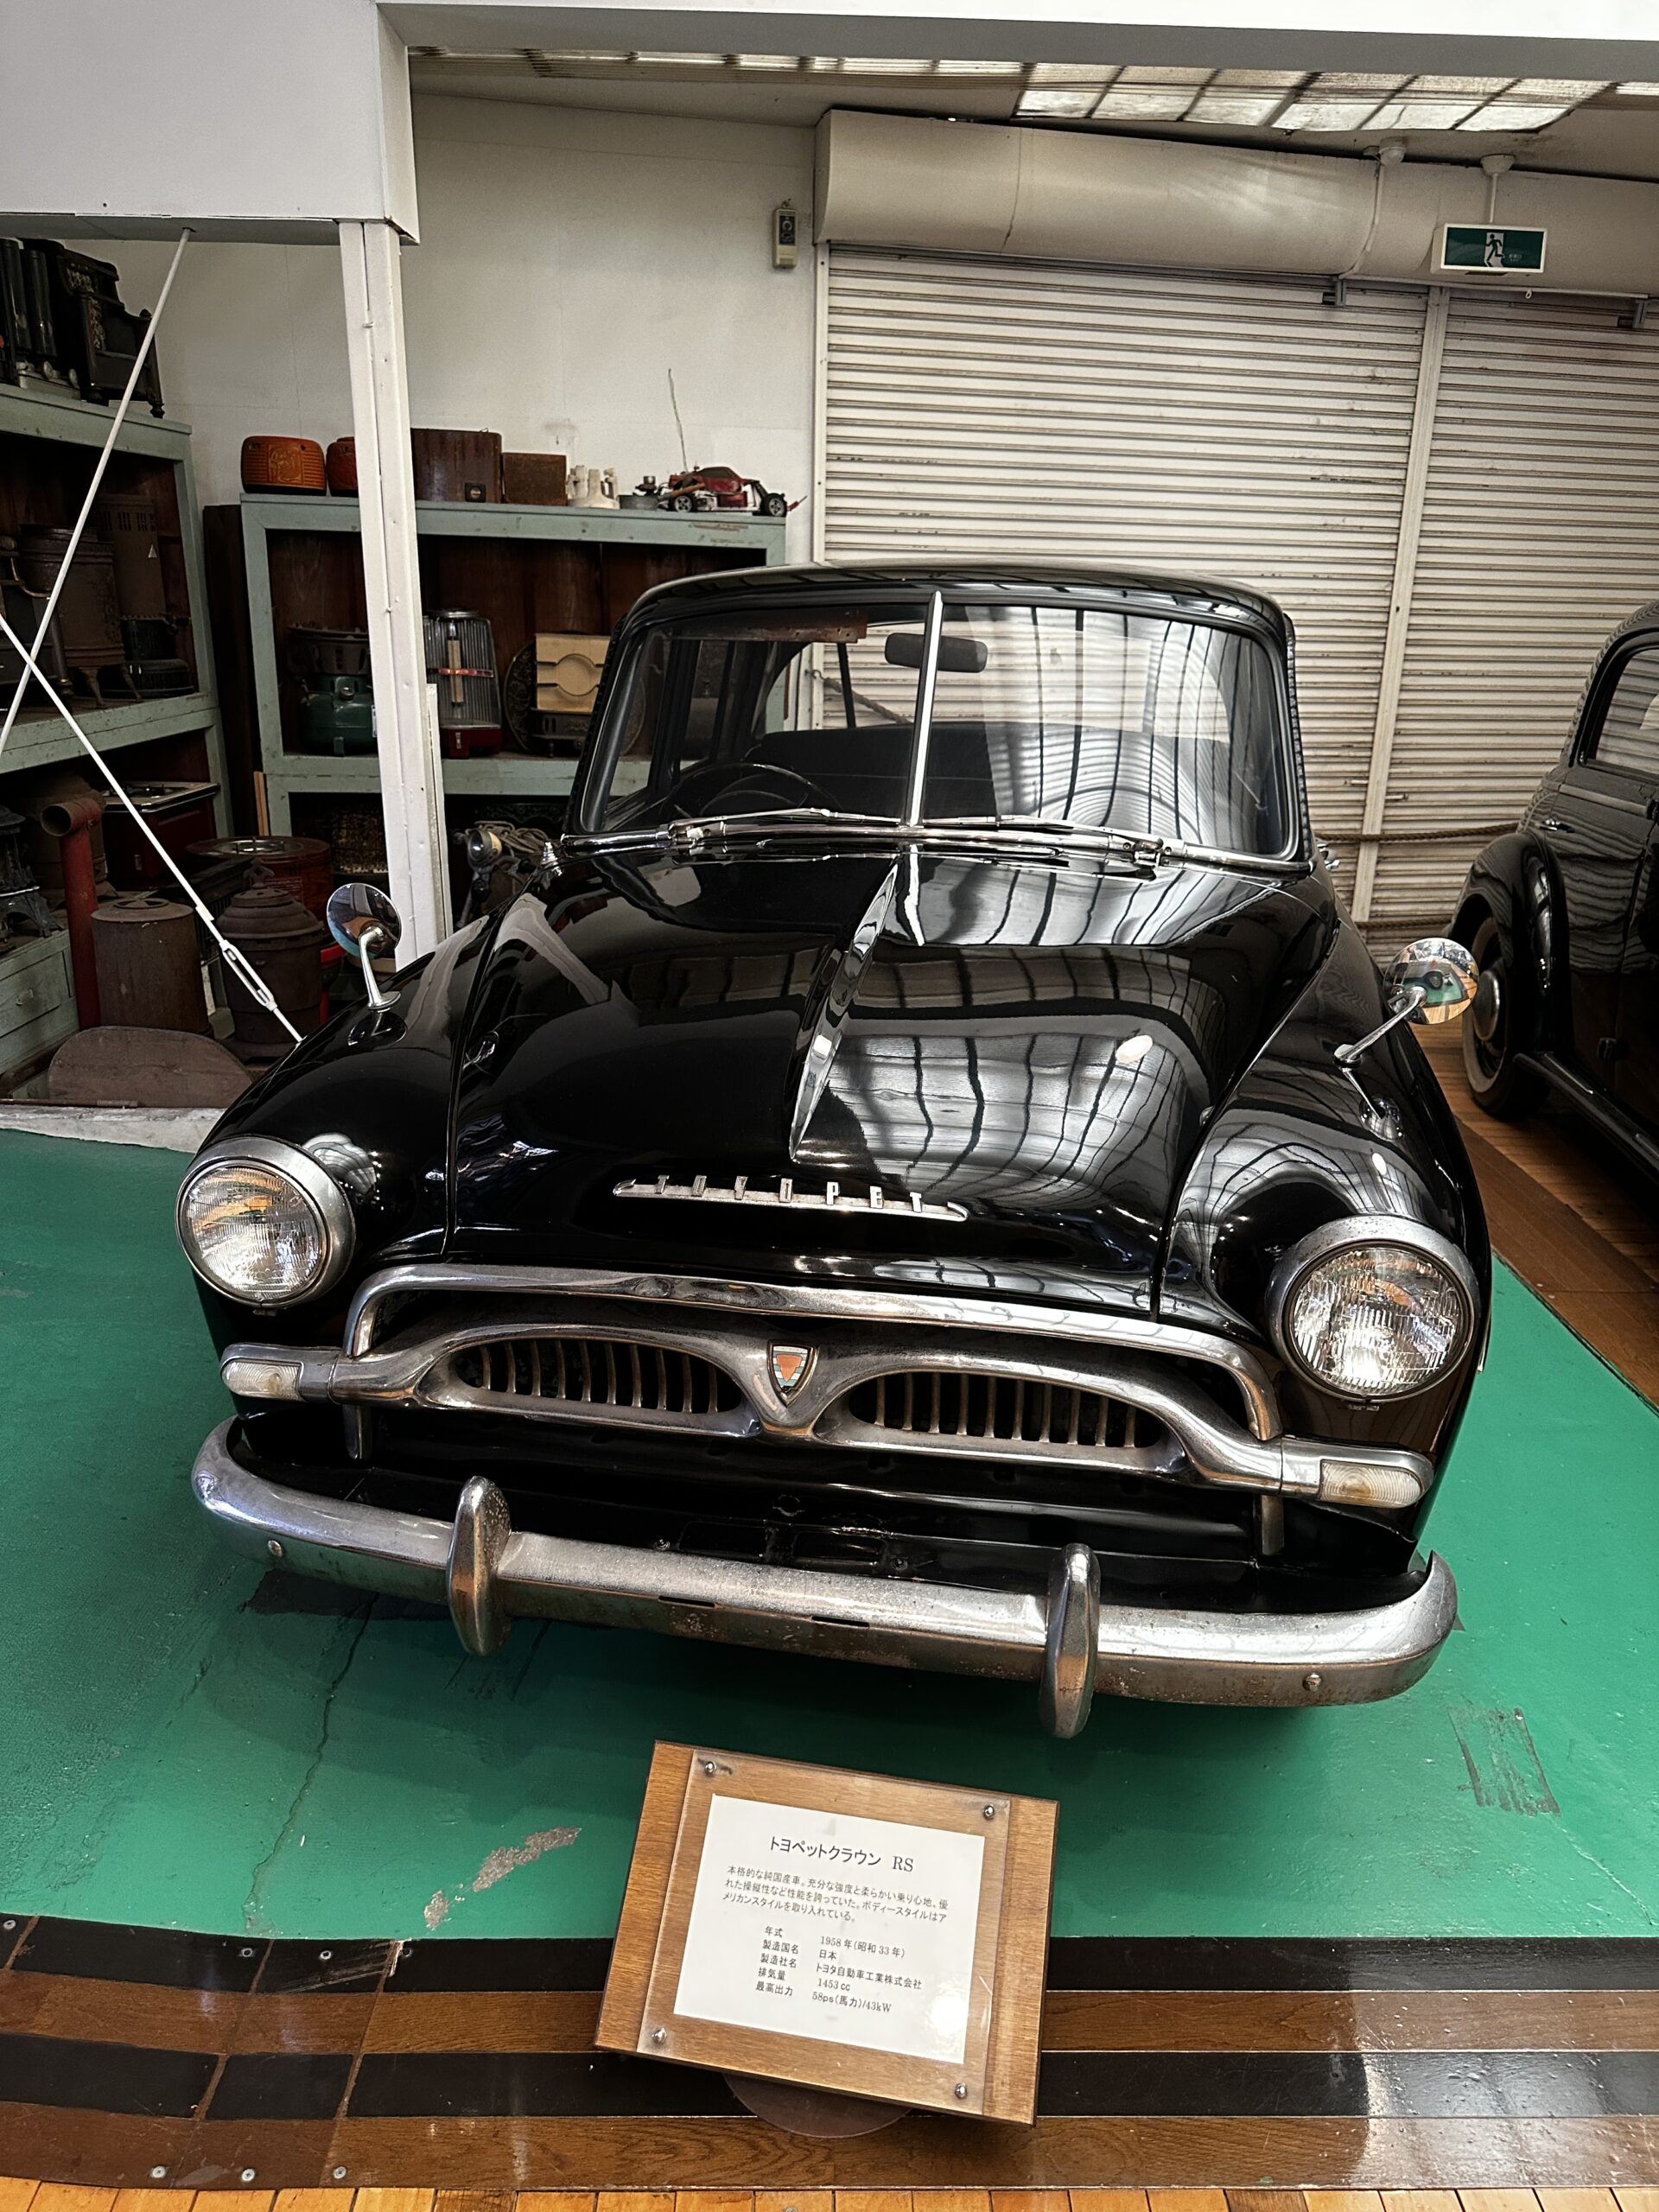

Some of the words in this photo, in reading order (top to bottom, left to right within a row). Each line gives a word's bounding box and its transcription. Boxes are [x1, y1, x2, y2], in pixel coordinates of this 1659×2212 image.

[654, 1174, 923, 1213] TOYOPET
[770, 1836, 881, 1866] トヨペットクラウン
[892, 1856, 914, 1872] RS
[765, 1926, 784, 1938] 年式
[762, 1939, 799, 1955] 製造国名
[819, 1949, 837, 1961] 日本
[760, 1953, 798, 1968] 製造社名
[758, 1967, 786, 1981] 排気量
[816, 1962, 922, 1990] トヨタ自動車工業株式会社
[756, 1980, 793, 1997] 最高出力
